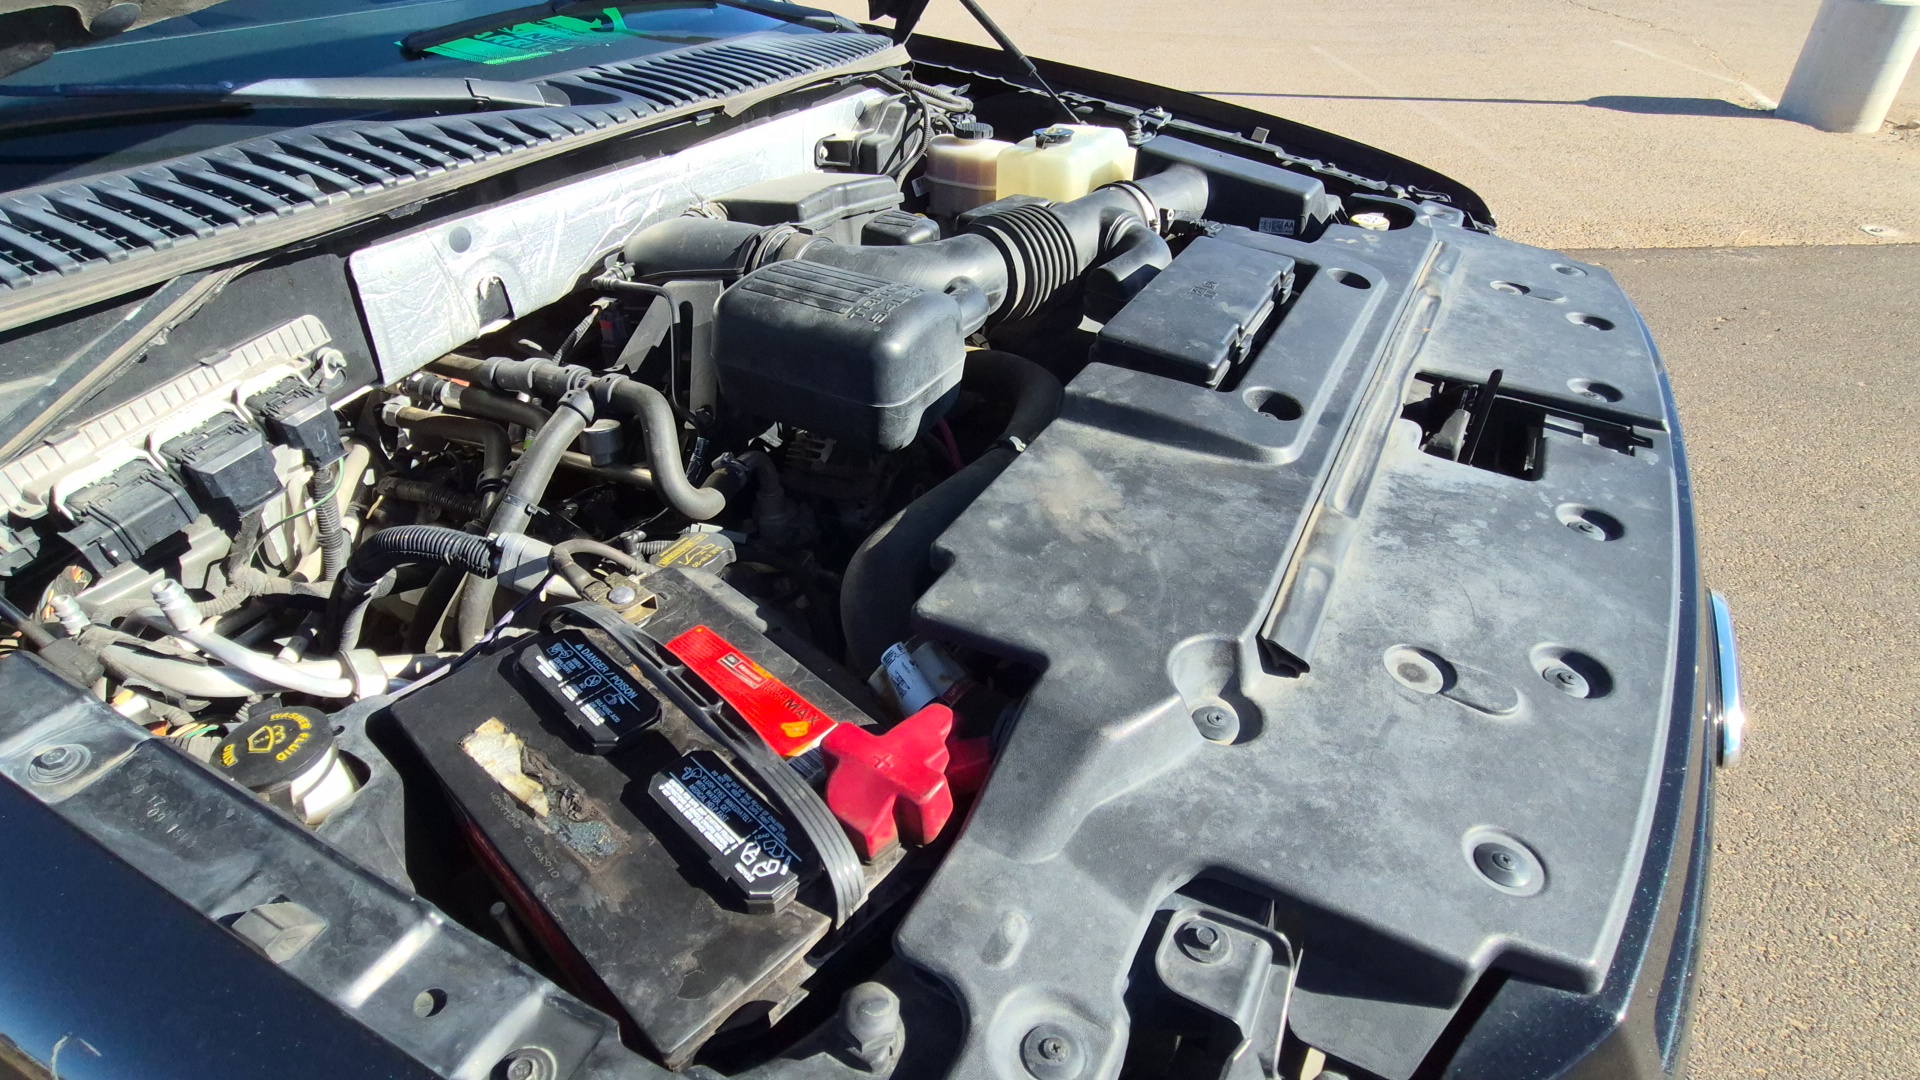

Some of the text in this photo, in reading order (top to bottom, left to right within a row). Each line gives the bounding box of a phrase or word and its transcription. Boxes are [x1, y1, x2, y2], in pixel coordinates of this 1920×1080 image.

[847, 284, 913, 319] TRITON
[580, 649, 609, 673] DANGER
[609, 675, 638, 699] POISON
[270, 712, 312, 729] WASHER
[609, 714, 620, 723] ACID
[785, 698, 823, 727] MAX
[276, 732, 310, 762] FLUID
[686, 784, 729, 822] MEDICAL HELP FAST
[694, 780, 707, 791] WITH
[718, 804, 731, 814] GET
[699, 776, 754, 824] FLUSH EYES IMMEDIATELY
[721, 774, 732, 783] KEEP
[742, 793, 752, 801] THE
[767, 824, 777, 832] AND
[774, 831, 788, 842] LEVEL
[523, 835, 560, 879] 01639570
